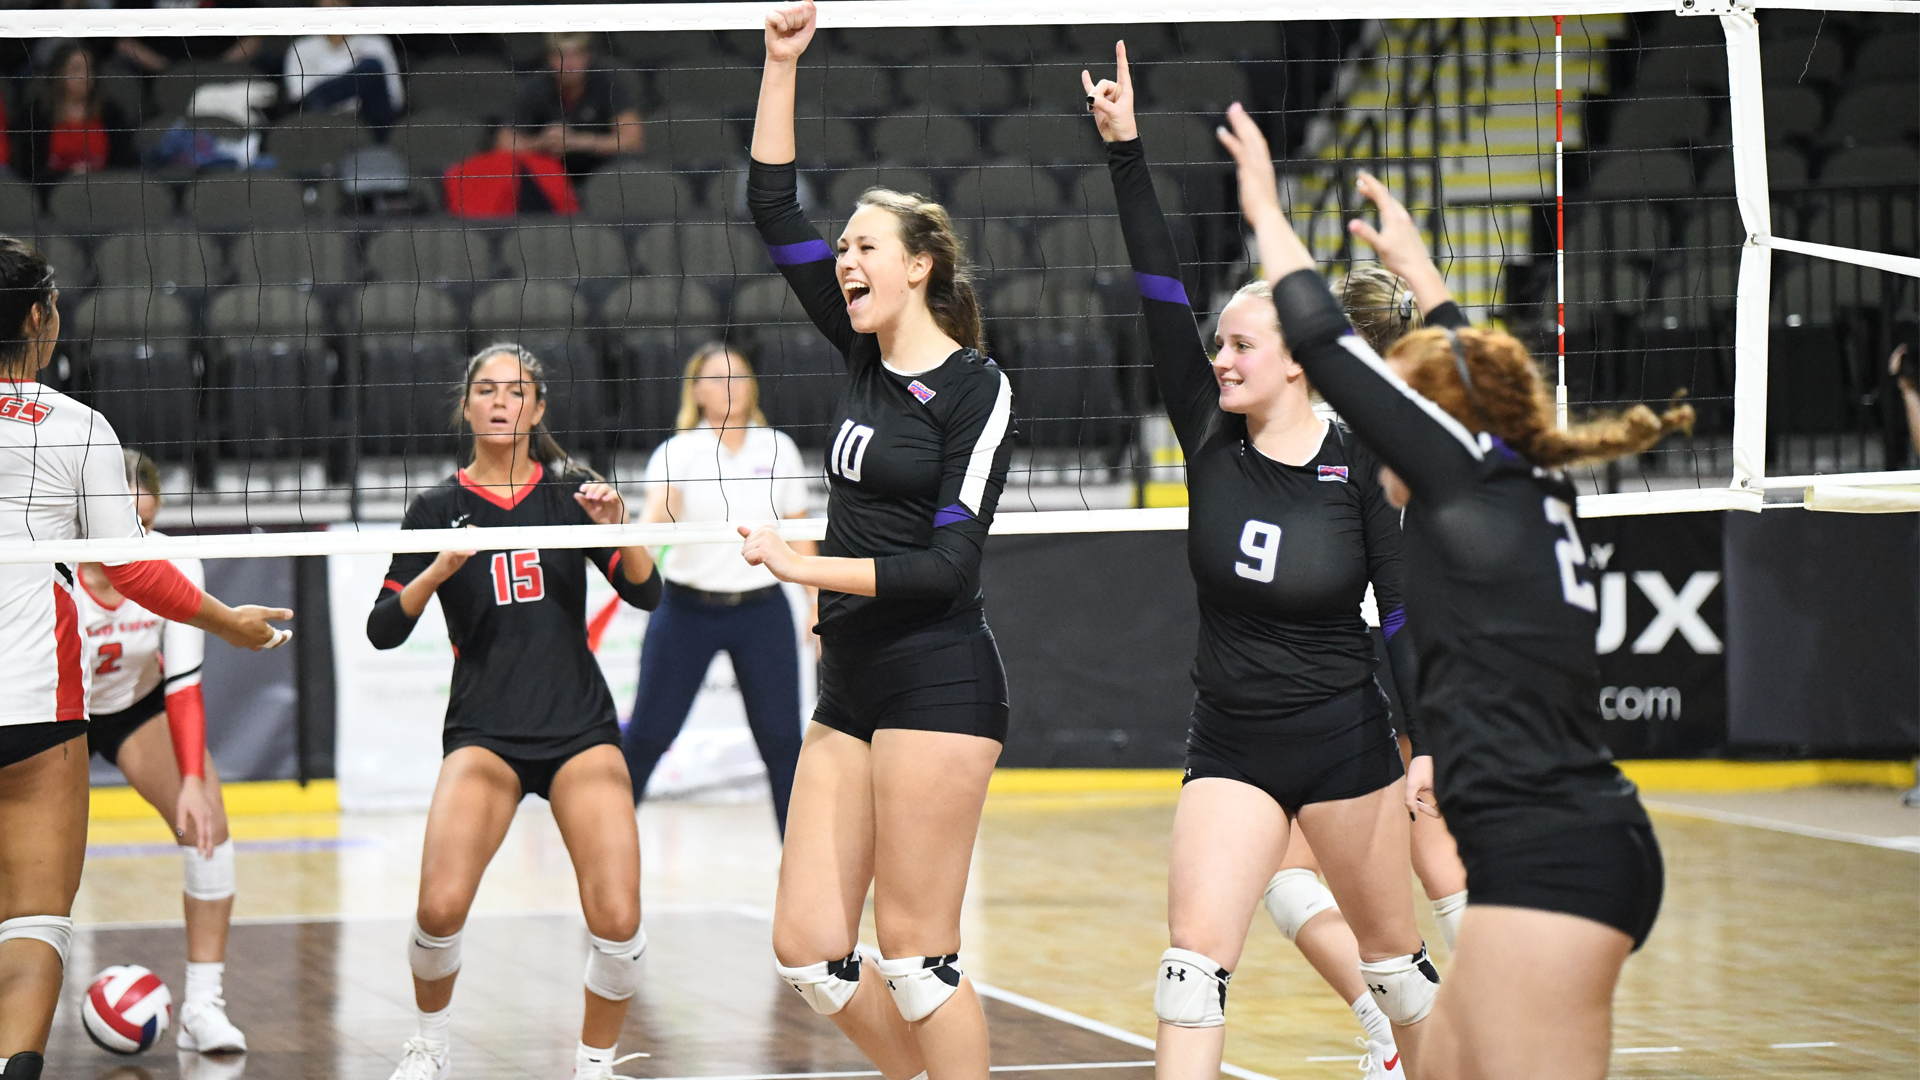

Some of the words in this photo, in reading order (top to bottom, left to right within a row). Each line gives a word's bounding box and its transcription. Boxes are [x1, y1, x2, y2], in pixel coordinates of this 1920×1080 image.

[831, 418, 874, 482] 10
[490, 549, 545, 606] 15
[1234, 519, 1282, 583] 9
[1588, 542, 1615, 570] Y
[96, 642, 122, 675] 2
